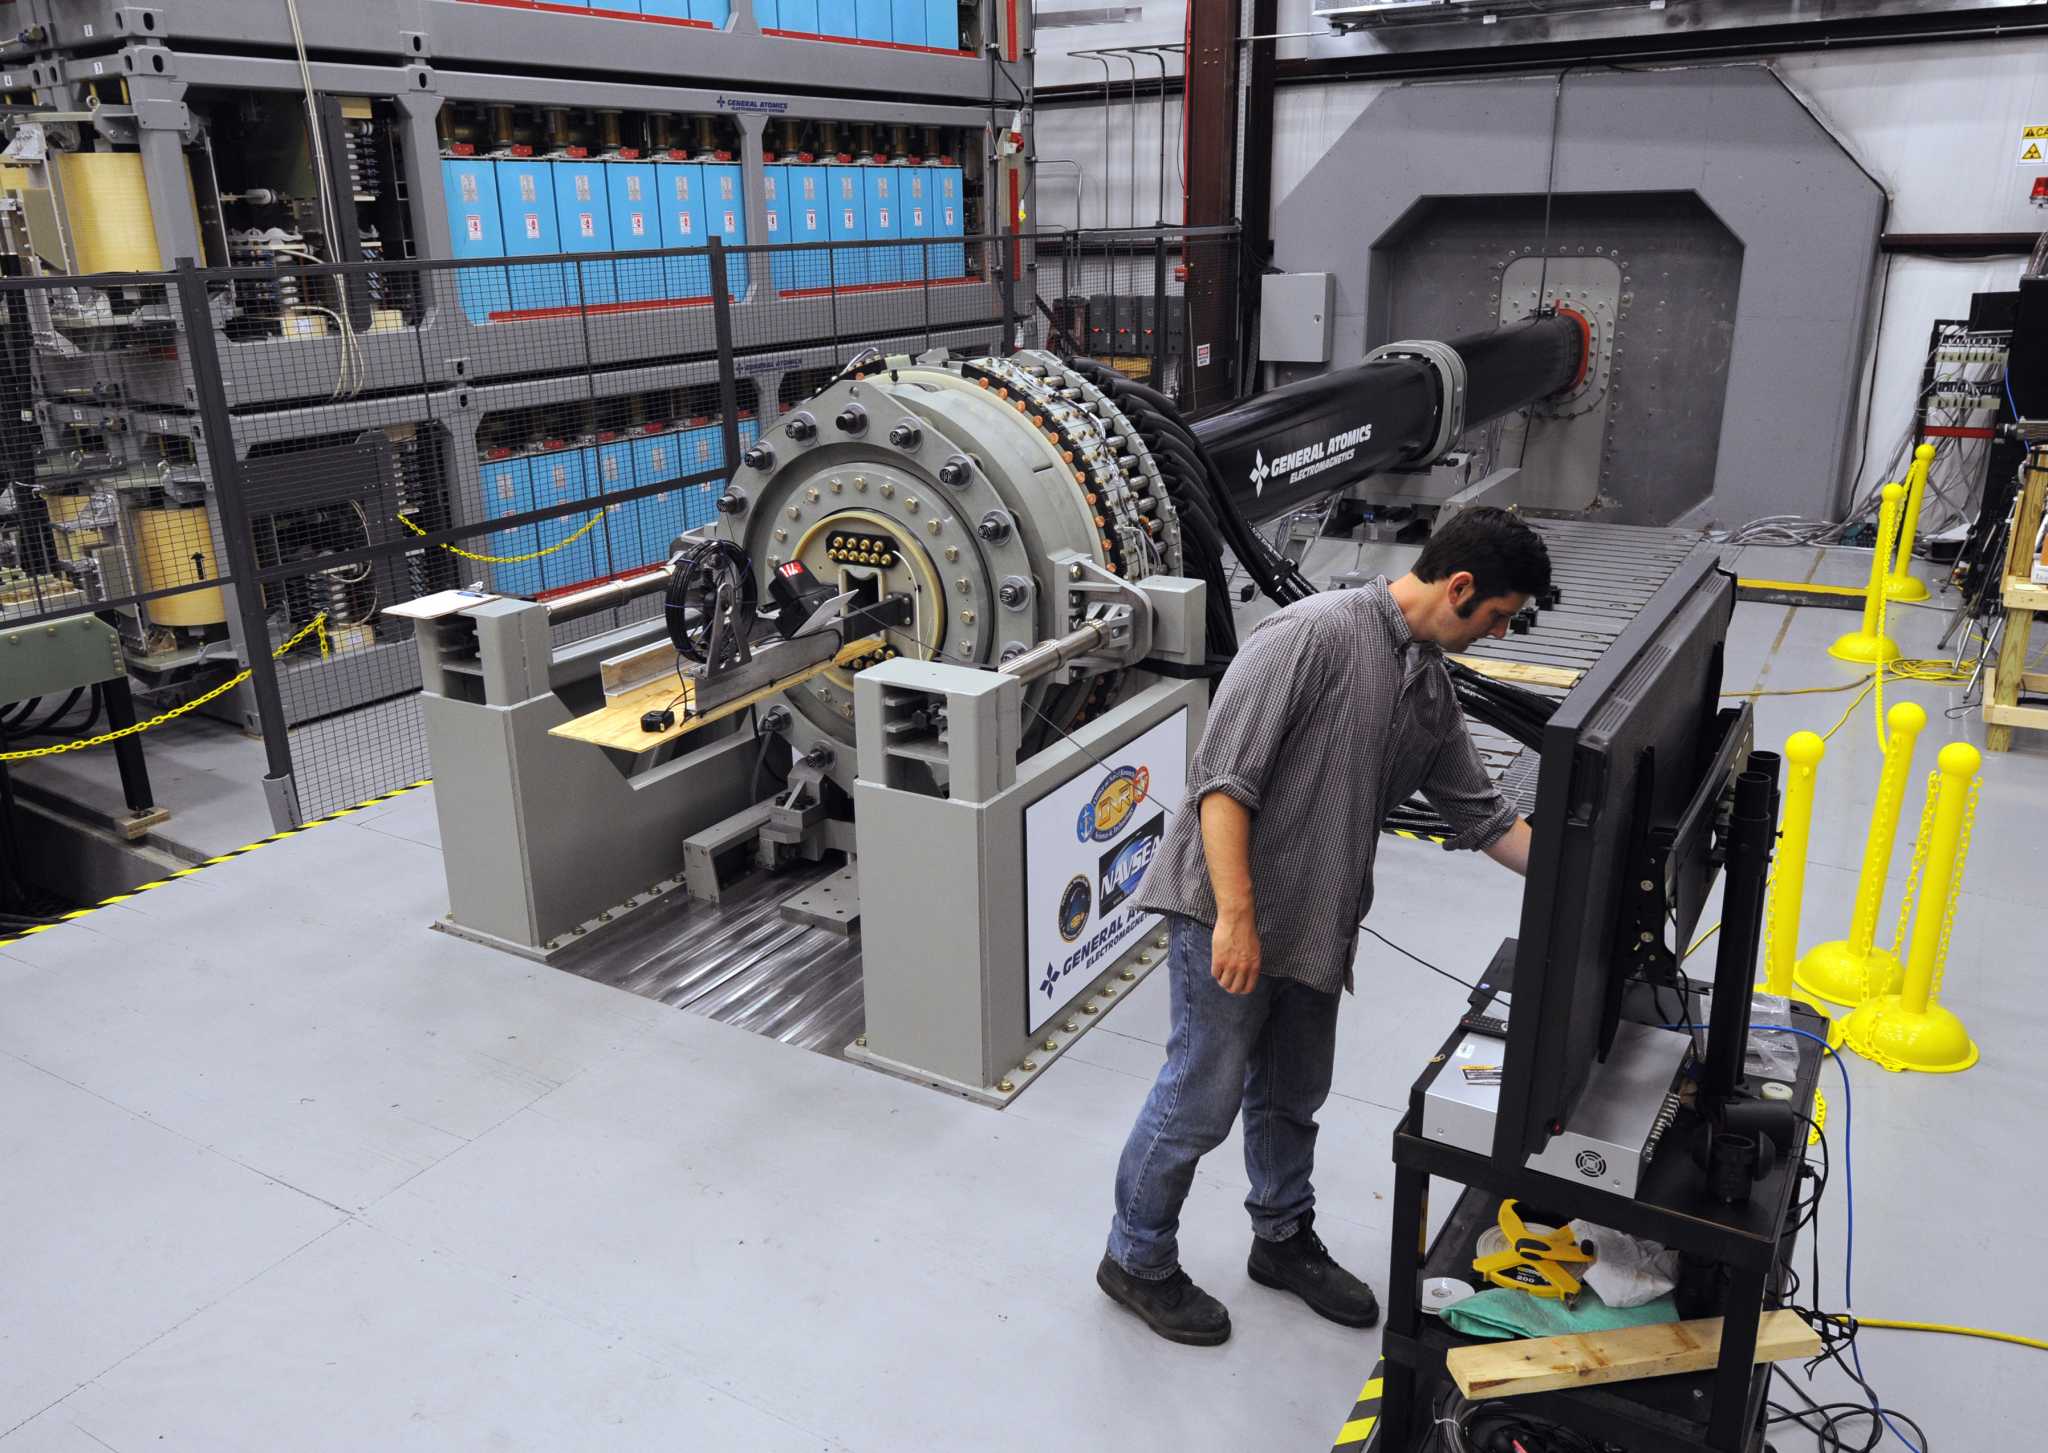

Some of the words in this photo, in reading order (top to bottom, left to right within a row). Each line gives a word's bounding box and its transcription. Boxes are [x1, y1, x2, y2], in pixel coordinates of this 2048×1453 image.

[1270, 442, 1325, 478] GENERAL
[1326, 423, 1373, 456] ATOMICS
[1288, 448, 1355, 485] ELECTROMAGNETICS
[1100, 834, 1161, 901] NAVSEA
[1062, 914, 1123, 977] GENERAL
[1516, 1275, 1536, 1284] 200
